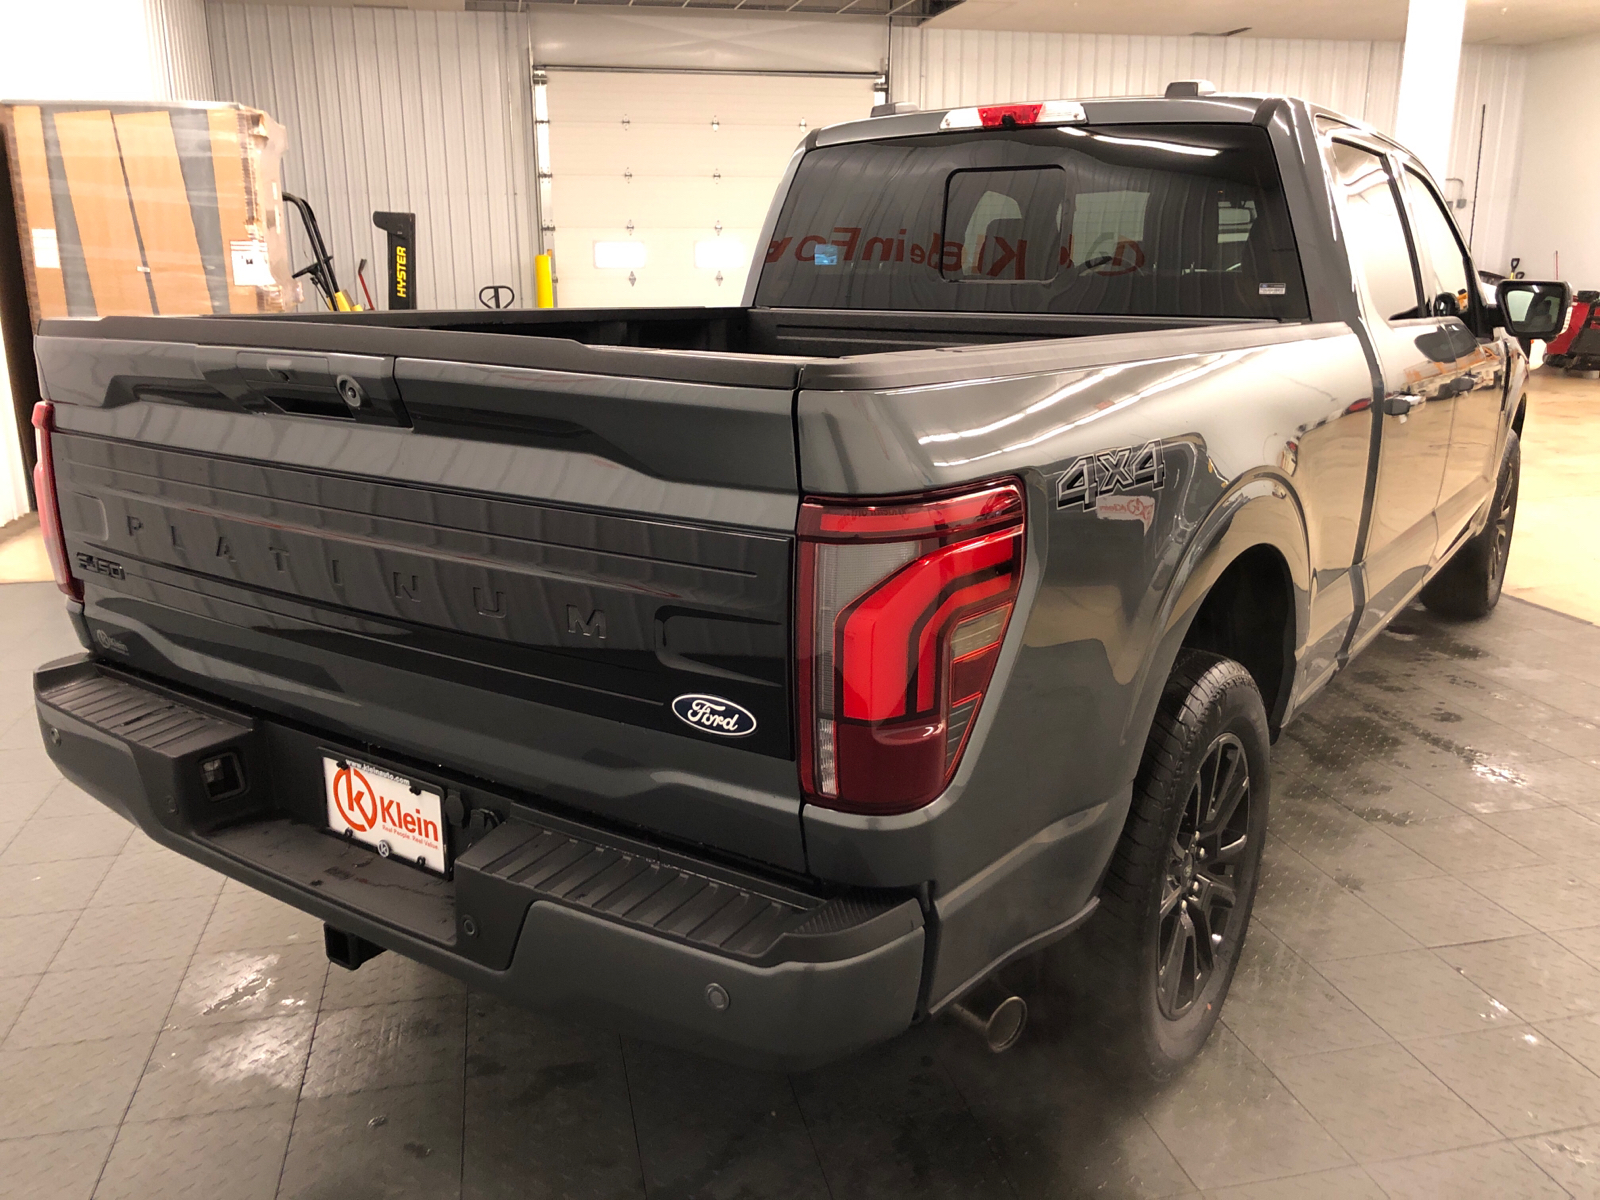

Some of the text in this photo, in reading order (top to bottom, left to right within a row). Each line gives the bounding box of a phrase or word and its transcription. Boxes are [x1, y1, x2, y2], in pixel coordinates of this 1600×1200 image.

[396, 245, 407, 298] HYSTER
[126, 515, 607, 639] PLATINUM
[687, 699, 740, 731] Ford
[345, 759, 411, 786] www.kleinauto.com
[380, 796, 439, 842] Klein
[382, 825, 393, 833] Real
[412, 836, 424, 845] Real
